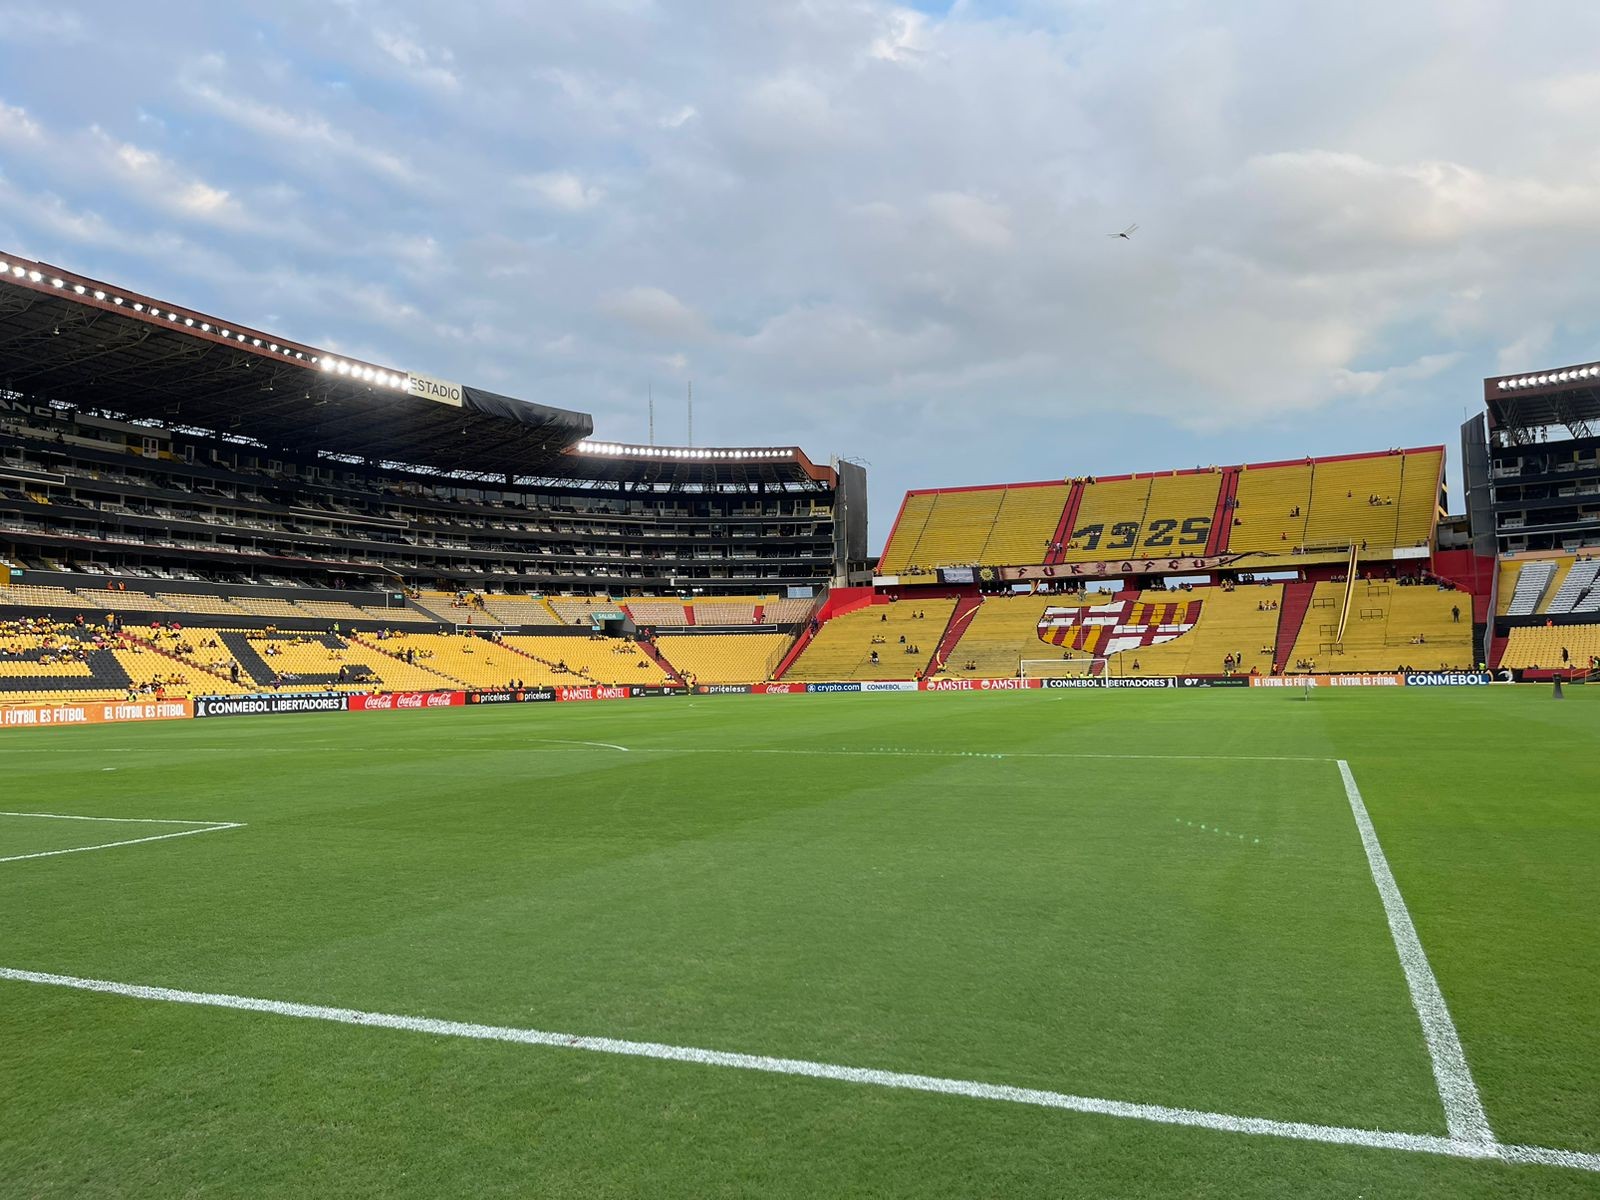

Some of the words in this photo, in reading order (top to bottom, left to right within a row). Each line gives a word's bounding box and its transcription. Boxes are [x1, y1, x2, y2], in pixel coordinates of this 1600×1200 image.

[410, 377, 460, 400] ESTADIO
[1072, 517, 1211, 550] 1925
[936, 680, 973, 691] AMSTEL
[1050, 679, 1099, 688] CONMEBOL
[1101, 679, 1166, 687] LBERTADORES
[1285, 678, 1293, 687] ES
[1330, 678, 1338, 686] EL
[1363, 677, 1372, 686] ES
[1407, 675, 1487, 686] CONMEBOL
[568, 687, 593, 699] AMSTEL
[602, 687, 625, 698] AMSTEL
[817, 683, 860, 692] crypto.com
[480, 692, 511, 703] priceless
[525, 691, 551, 701] priceless
[104, 706, 114, 719] EL
[145, 704, 155, 717] ES
[208, 701, 270, 714] CONMEBOL
[272, 698, 339, 711] LIBERTADORES
[6, 706, 37, 724] FÚTBOL
[40, 708, 51, 722] ES
[54, 705, 87, 722] FÚTBOL
